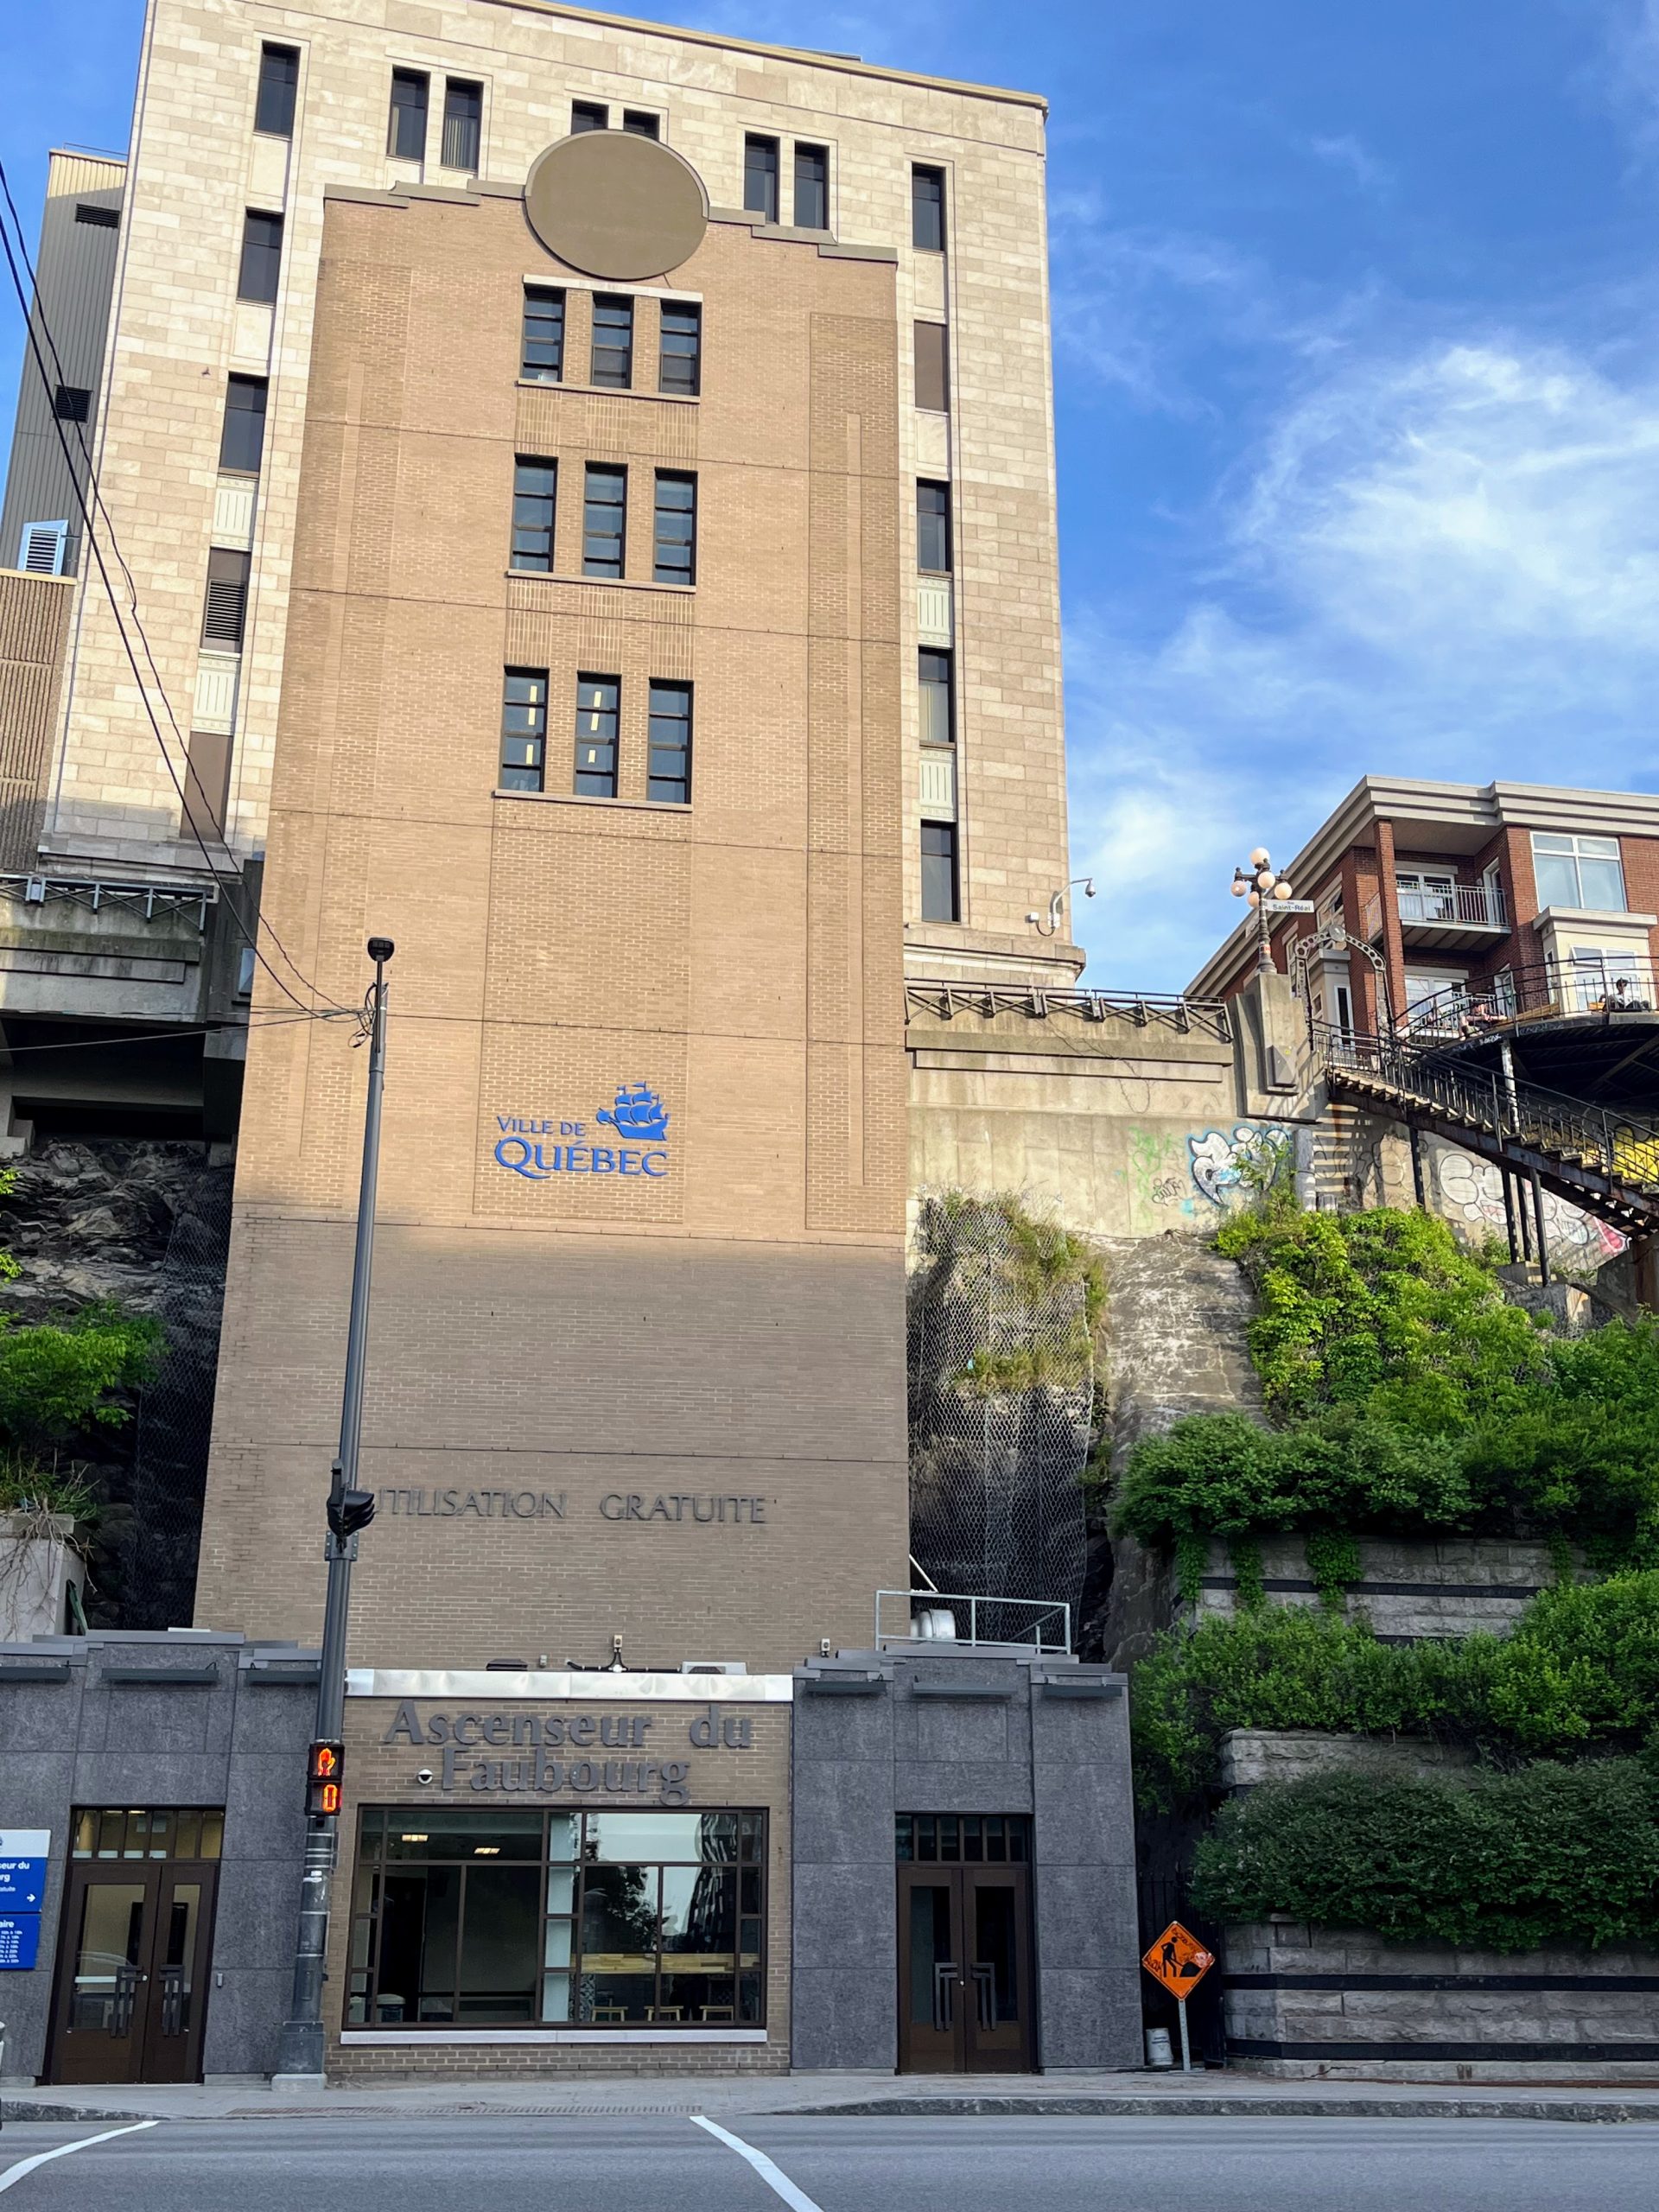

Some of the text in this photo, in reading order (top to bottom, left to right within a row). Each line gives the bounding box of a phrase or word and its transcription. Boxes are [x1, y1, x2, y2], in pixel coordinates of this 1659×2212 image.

[497, 1116, 587, 1136] VILLE DE
[494, 1135, 669, 1179] QUÉBEC
[599, 1493, 766, 1523] GRATUITE
[385, 1700, 752, 1748] Ascenseur du
[441, 1746, 691, 1807] Faubourg
[322, 1784, 338, 1812] 0
[17, 1860, 30, 1870] du
